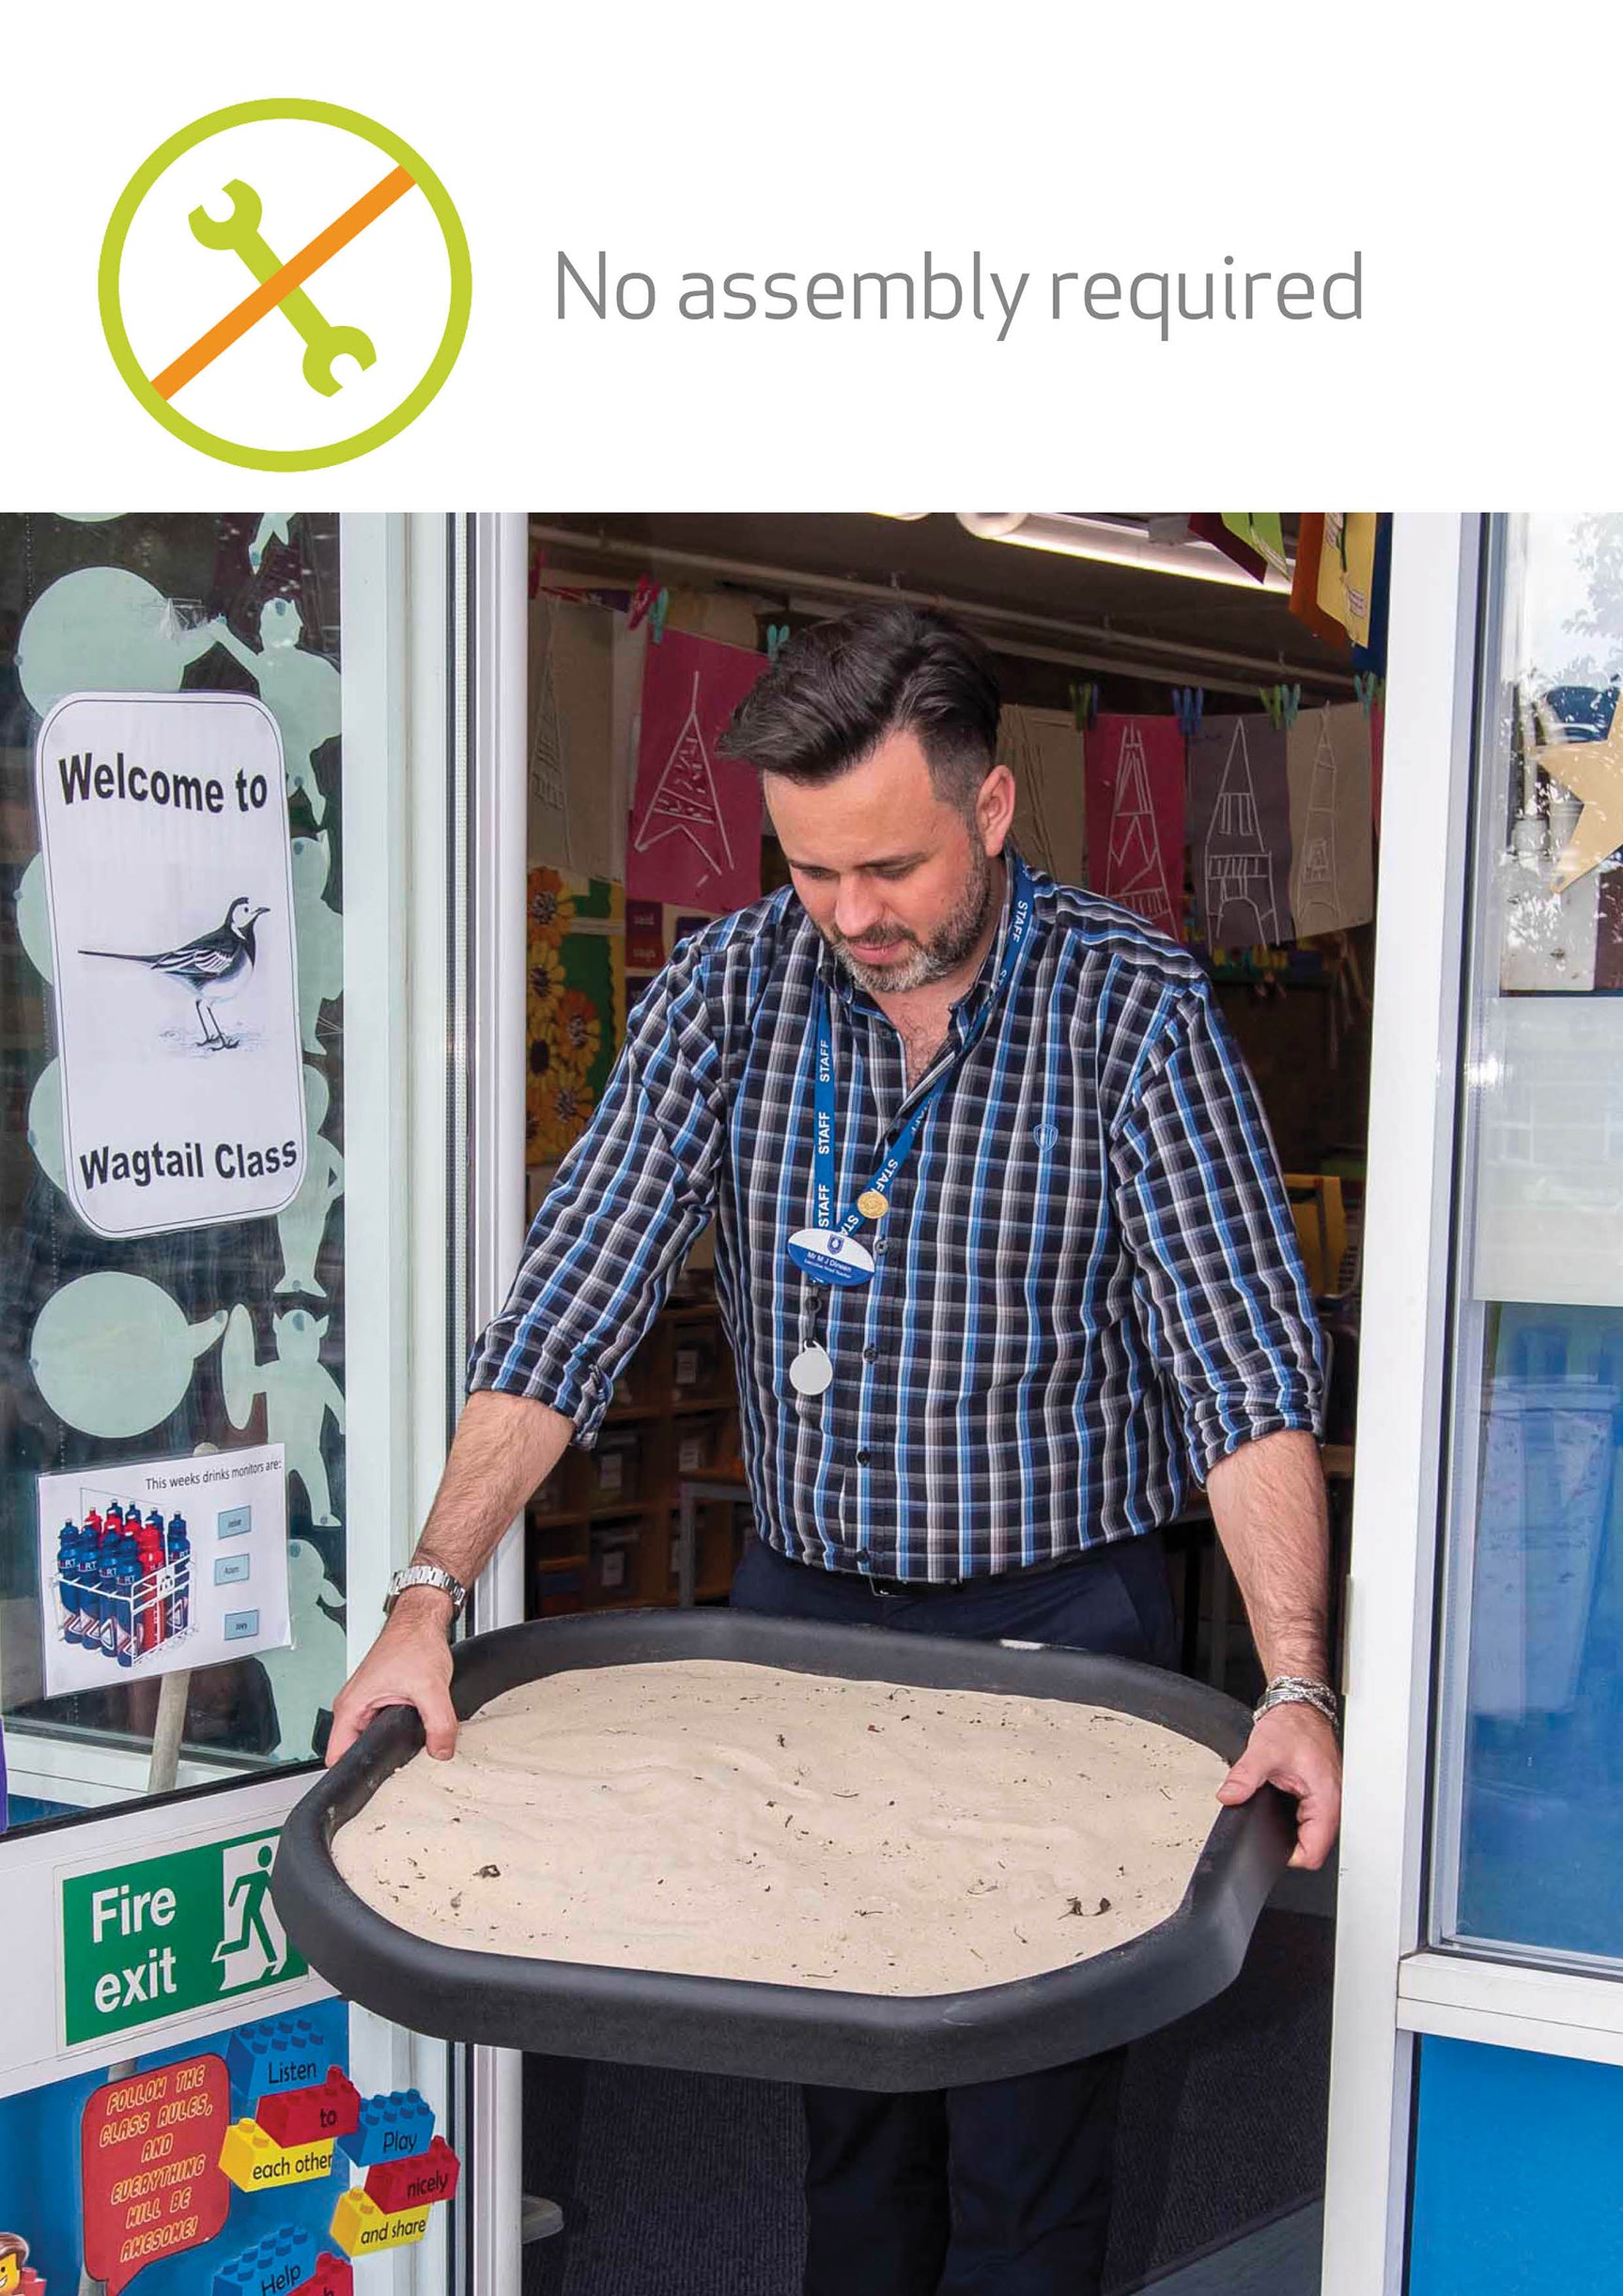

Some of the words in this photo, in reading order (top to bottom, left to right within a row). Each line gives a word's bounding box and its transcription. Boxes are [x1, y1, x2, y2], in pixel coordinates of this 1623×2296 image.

[58, 752, 224, 814] Welcome
[237, 768, 268, 813] to
[1012, 900, 1028, 942] STAFF
[820, 1039, 830, 1082] STAFF
[818, 1111, 830, 1155] STAFF
[79, 1142, 204, 1189] Wagtail
[216, 1139, 298, 1179] Class
[871, 1158, 899, 1193] STAF
[818, 1184, 830, 1228] STAFF
[145, 1477, 167, 1490] This
[169, 1472, 200, 1488] weeks
[202, 1468, 230, 1482] drinks
[231, 1463, 264, 1478] monitors
[265, 1459, 282, 1471] are:
[92, 1884, 177, 1944] Fire
[94, 1947, 178, 2013] exit
[106, 2076, 167, 2116] FOLLOW
[176, 2064, 206, 2093] THE
[268, 2061, 317, 2084] Listen
[100, 2112, 150, 2148] CLASS
[156, 2093, 213, 2129] RULES,
[319, 2108, 336, 2128] to
[141, 2133, 173, 2163] AND
[383, 2130, 417, 2153] Play
[111, 2154, 206, 2205] EVERYTHING
[253, 2156, 290, 2180] each
[295, 2151, 332, 2173] other
[407, 2170, 449, 2199] nicely
[125, 2198, 161, 2229] WILL
[169, 2186, 192, 2213] BE
[119, 2215, 198, 2263] AWESOME!
[361, 2222, 389, 2244] and
[392, 2219, 426, 2238] share
[261, 2264, 301, 2296] Help
